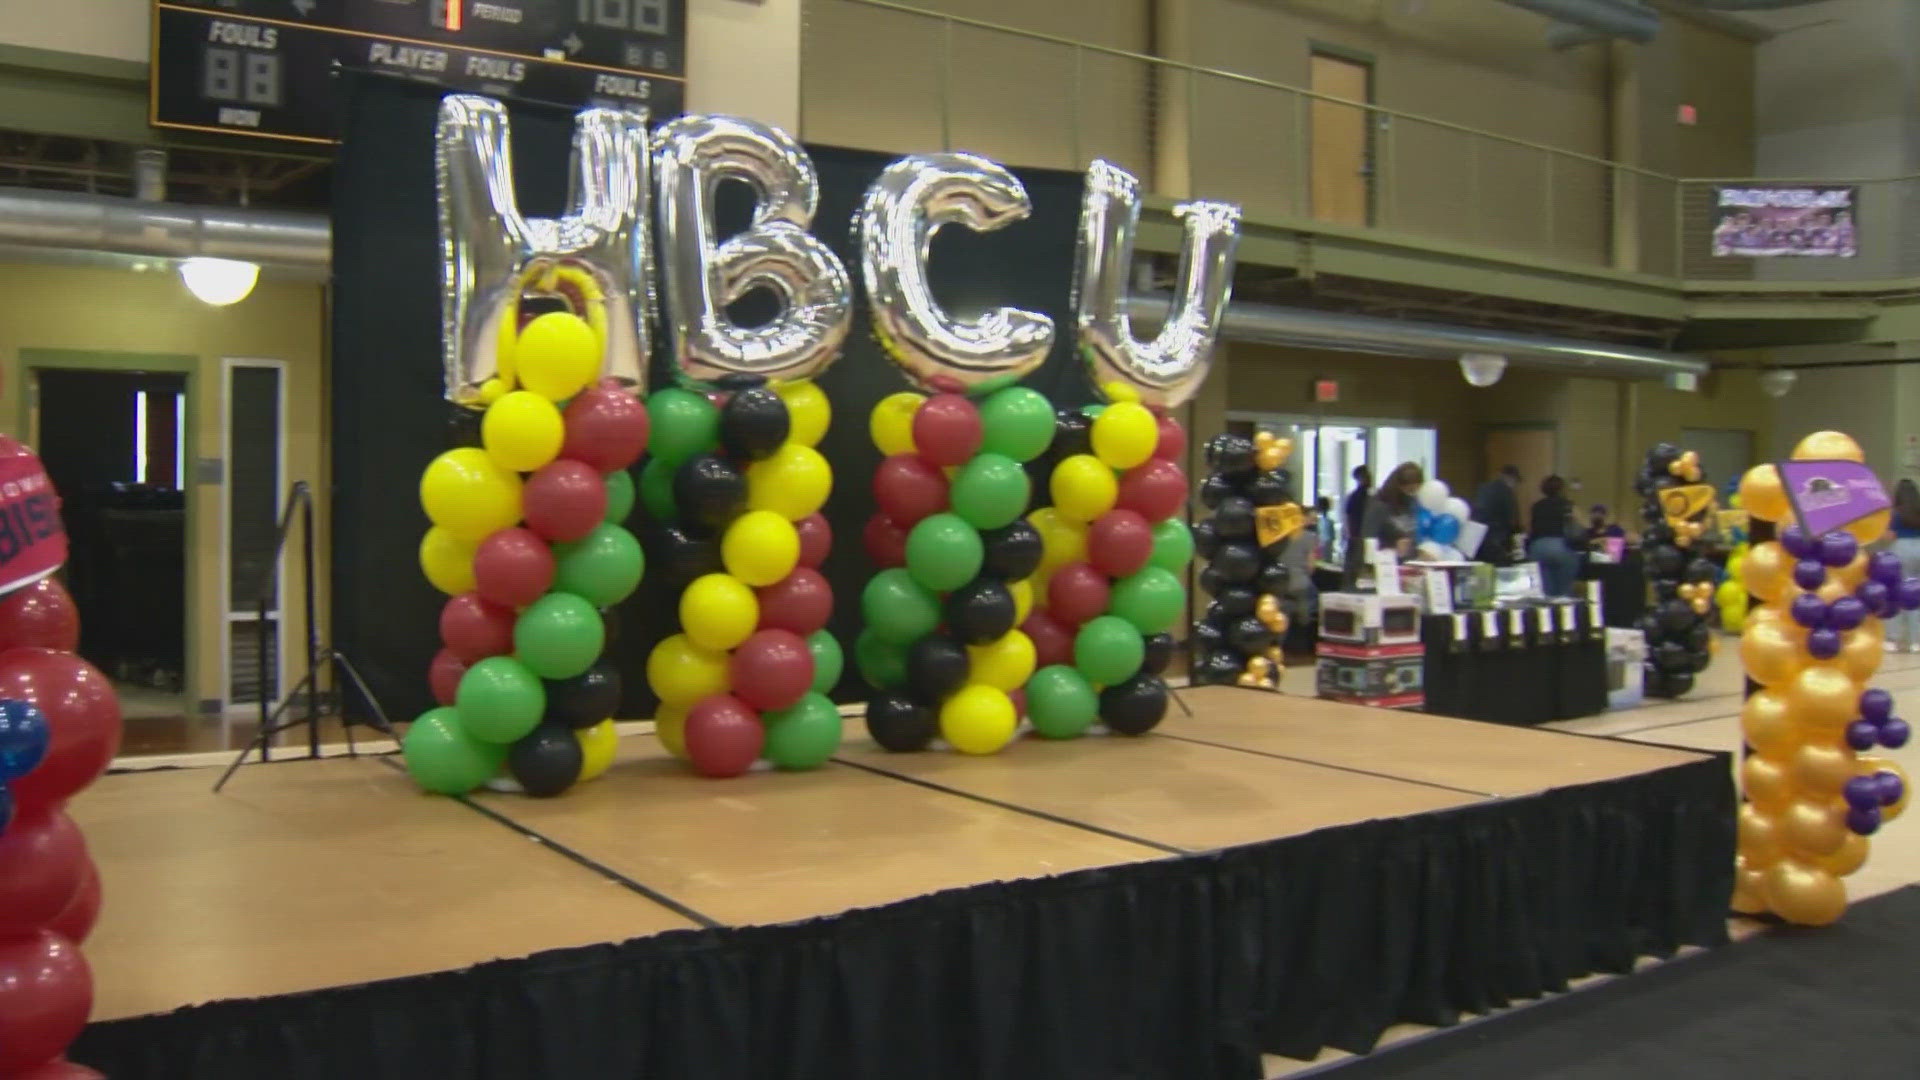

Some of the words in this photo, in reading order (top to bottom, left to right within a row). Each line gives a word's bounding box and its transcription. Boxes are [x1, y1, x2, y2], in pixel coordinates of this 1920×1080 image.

[471, 2, 524, 24] PERIOD
[208, 20, 279, 50] FOULS
[369, 42, 449, 72] PLAYER
[464, 55, 526, 82] FOULS
[594, 73, 652, 99] FOULS
[436, 94, 1243, 408] HBCU
